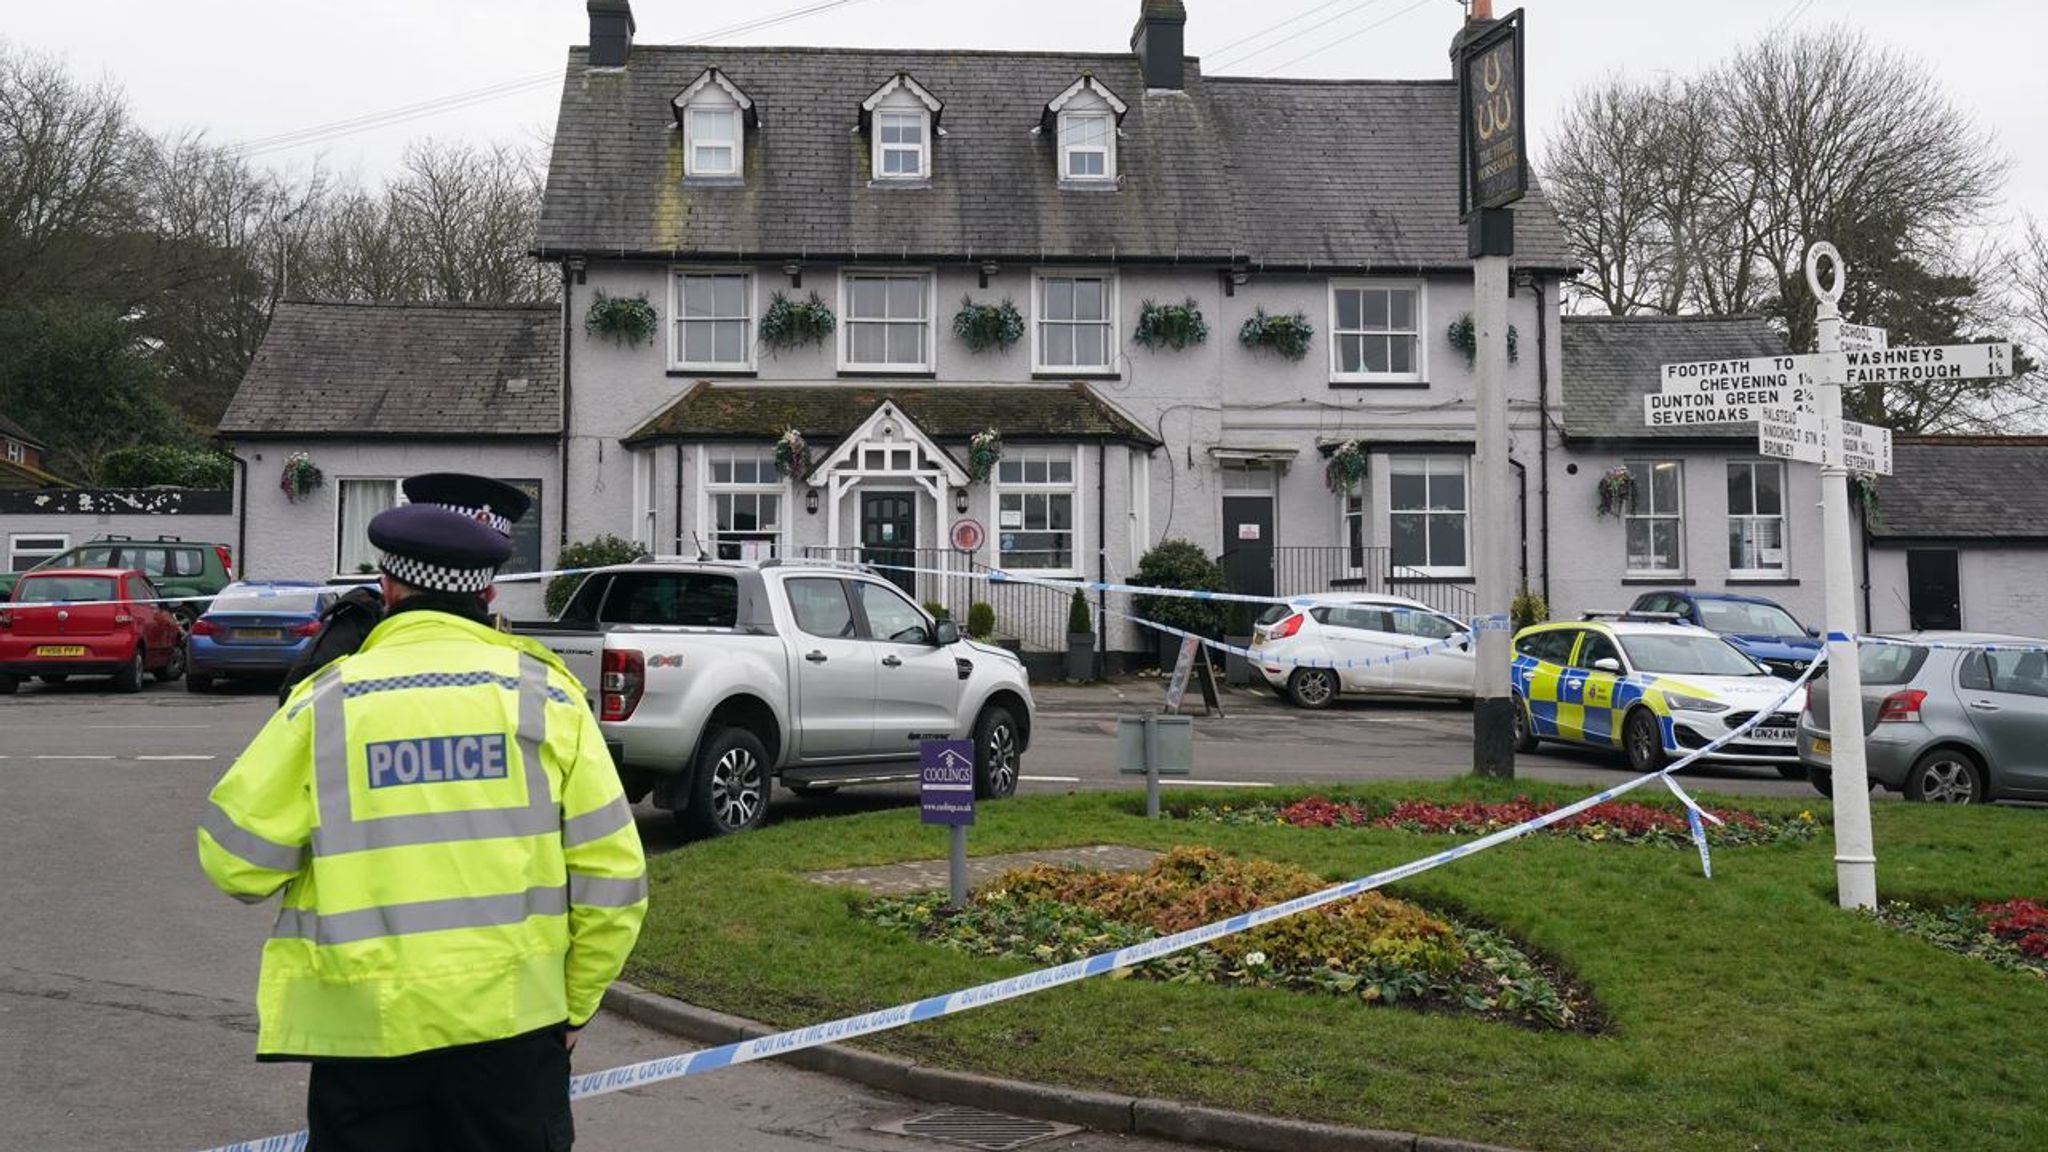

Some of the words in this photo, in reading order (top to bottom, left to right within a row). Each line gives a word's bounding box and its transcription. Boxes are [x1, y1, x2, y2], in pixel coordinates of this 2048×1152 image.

[1846, 349, 1944, 366] WASHNEYS
[1668, 361, 1750, 378] FOOTPATH
[1774, 358, 1794, 371] TO
[1846, 364, 1961, 382] FAIRTROUGH
[1700, 374, 1788, 391] CHEVENING
[1652, 394, 1714, 409] DUNTON
[1726, 390, 1779, 405] GREEN
[1652, 408, 1749, 424] SEVENOAKS
[1842, 422, 1862, 438] UDHAM
[1842, 453, 1875, 471] ESTERHAM
[1754, 729, 1779, 738] GN24
[370, 735, 505, 787] POLICE
[923, 767, 969, 781] COOLINGS
